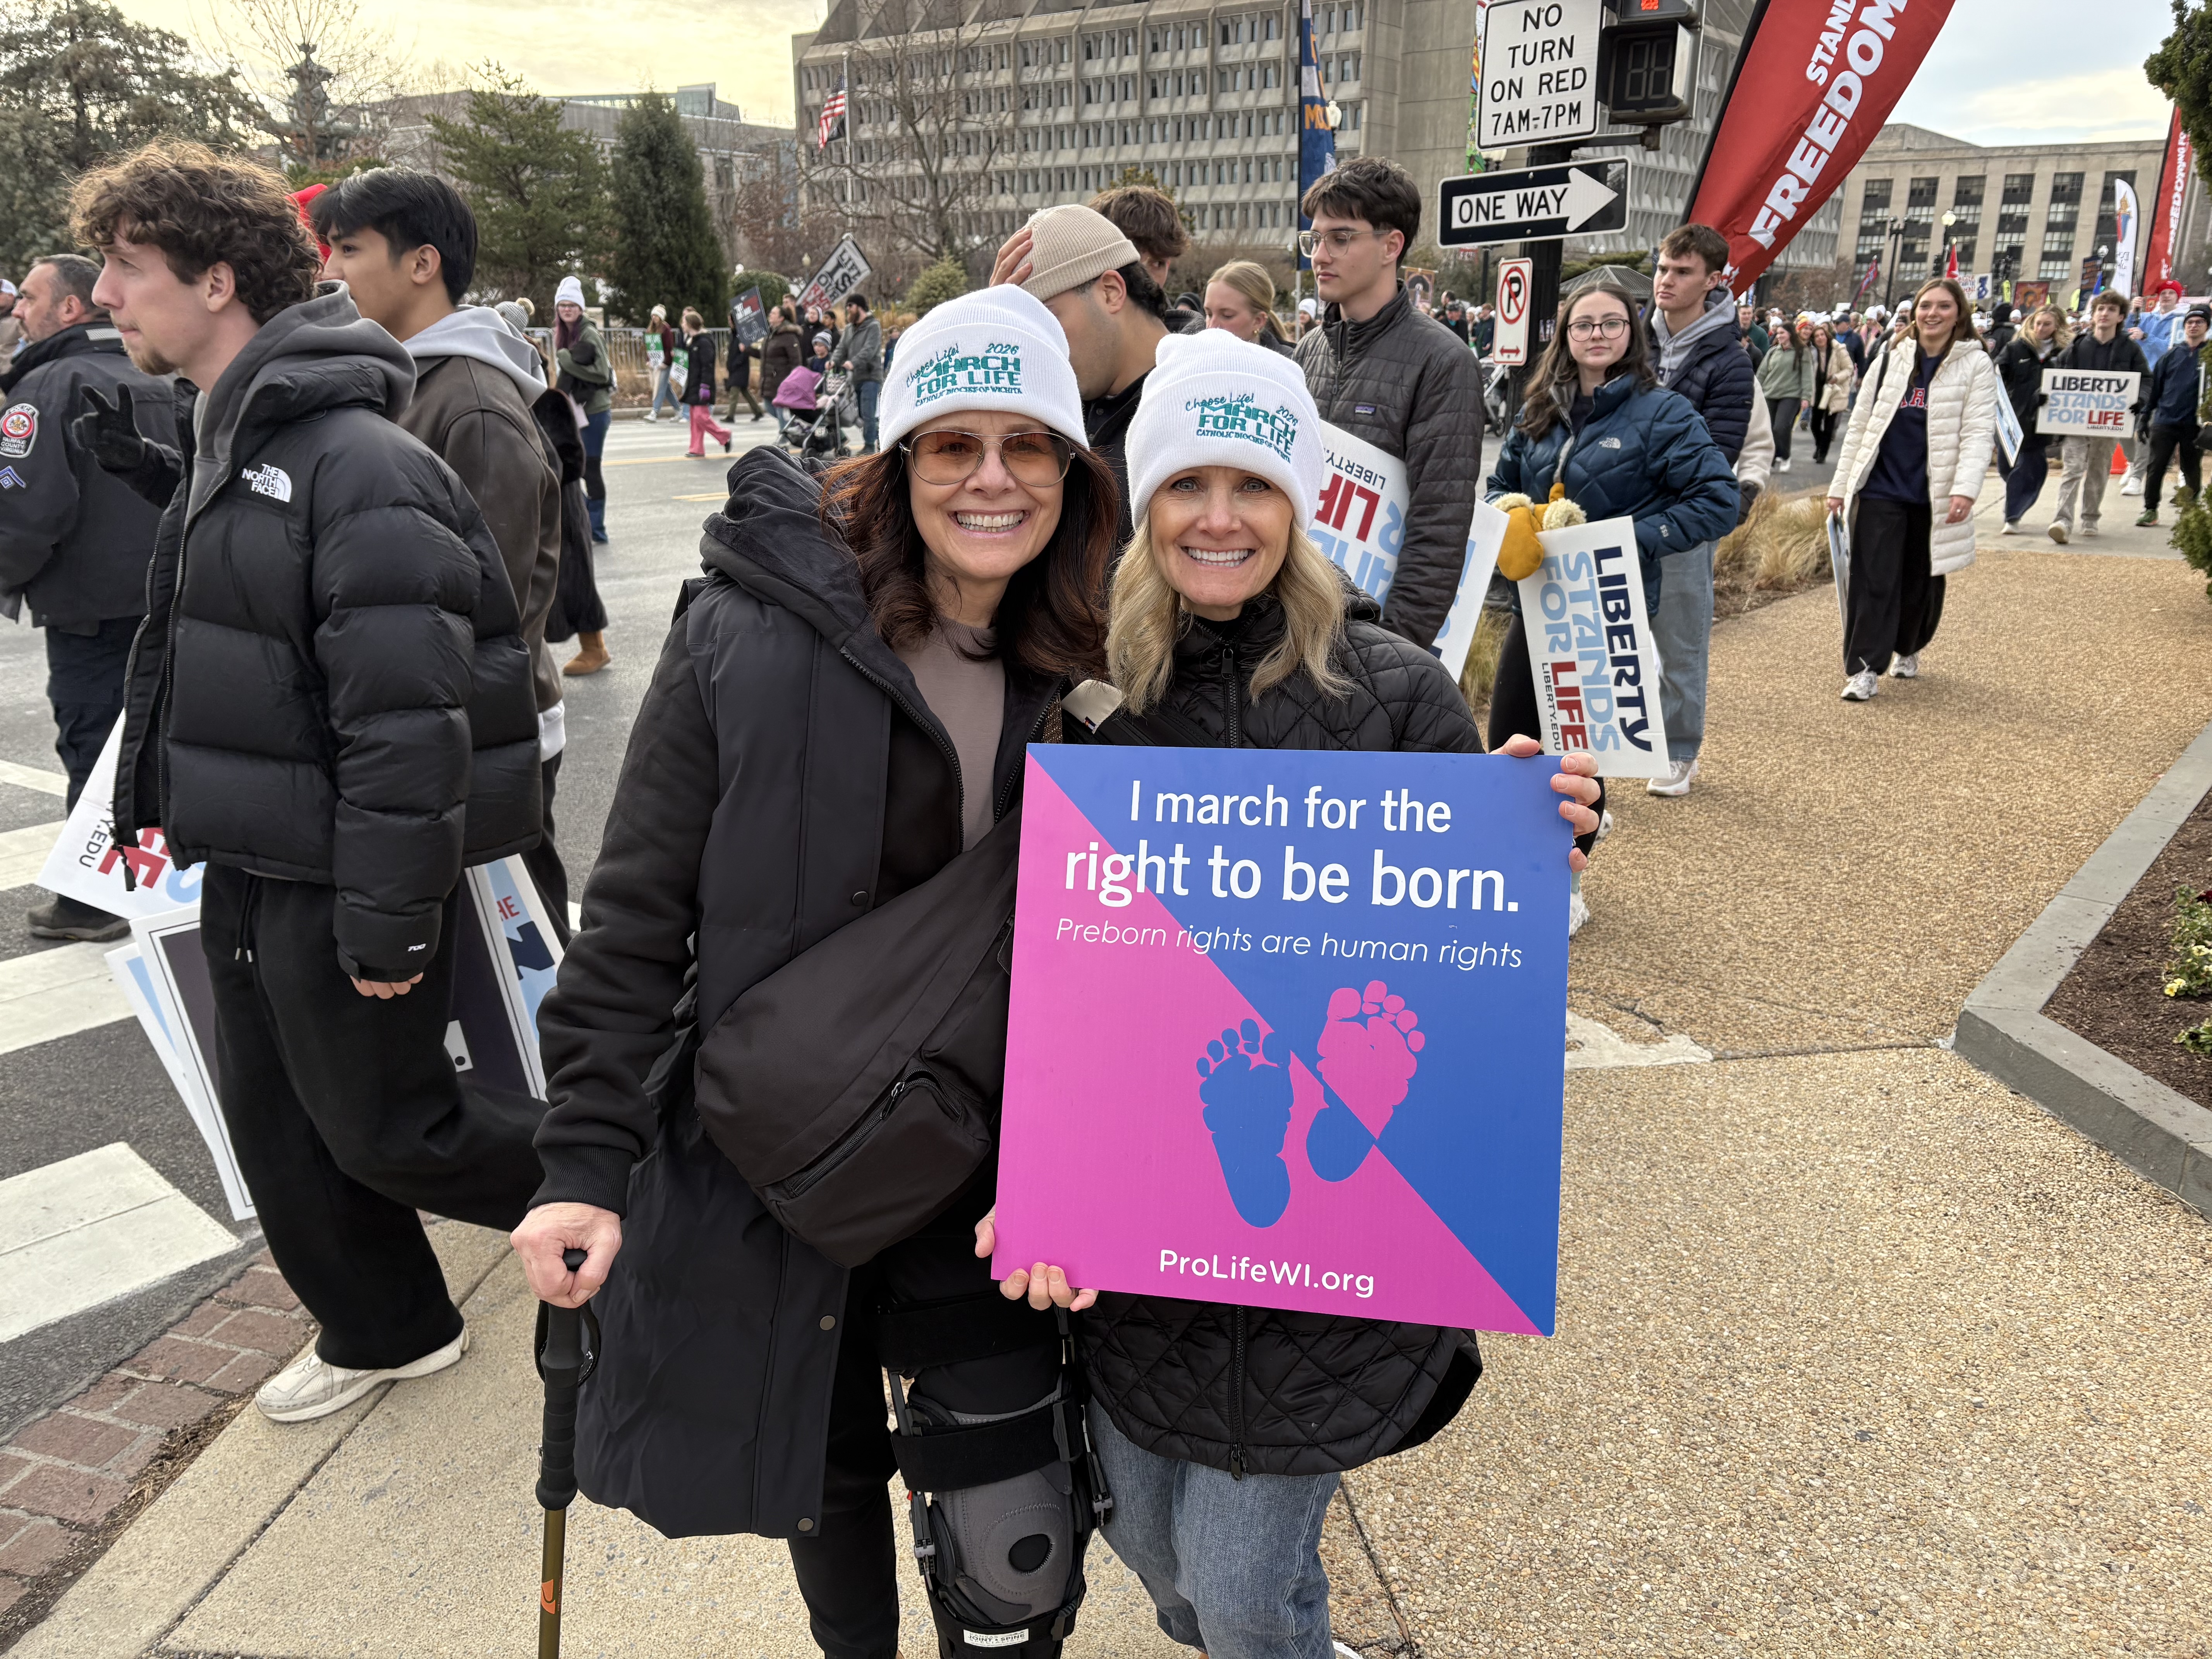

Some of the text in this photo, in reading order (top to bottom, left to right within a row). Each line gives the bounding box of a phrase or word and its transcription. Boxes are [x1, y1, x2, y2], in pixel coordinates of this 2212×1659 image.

[1523, 3, 1563, 32] NO
[1508, 34, 1575, 68] TURN
[1491, 66, 1587, 102] ON RED
[1491, 100, 1582, 136] 7AM-7PM
[1748, 0, 1908, 250] FREEDOM
[1458, 187, 1568, 224] ONE WAY
[826, 259, 852, 294] IS
[906, 343, 959, 388] Choose Life!
[985, 343, 1019, 355] 2026
[916, 371, 1022, 398] FOR LIFE
[917, 356, 1021, 384] MARCH
[2051, 376, 2130, 393] LIBERTY
[915, 389, 945, 407] CATHOLIC
[990, 386, 1023, 394] WICHITA
[1185, 392, 1254, 411] Choose Life!
[2049, 392, 2128, 410] STANDS
[1200, 403, 1296, 443] MARCH
[1276, 405, 1298, 426] 2026
[2047, 408, 2125, 426] FOR LIFE
[0, 446, 24, 454] VIRGINIA
[1196, 429, 1234, 438] CATHOLIC
[1265, 440, 1273, 449] OF
[1198, 414, 1293, 456] FOR LIFE
[242, 468, 276, 488] NORTH
[261, 463, 279, 477] THE
[1324, 448, 1386, 490] LIBERTY.
[251, 481, 276, 497] FACE
[1314, 473, 1381, 543] LIF
[1540, 553, 1589, 751] FOR LIFE
[1563, 551, 1621, 752] STANDS
[1593, 546, 1653, 753] LIBERTY
[1542, 662, 1561, 751] LIBERTY.EDU
[1131, 780, 1451, 833] I march for the
[1065, 839, 1518, 912] right to be born.
[1056, 918, 1522, 971] Preborn rights are human rights
[1160, 1249, 1374, 1298] ProLifeWI.org
[1000, 1633, 1025, 1641] SPINE
